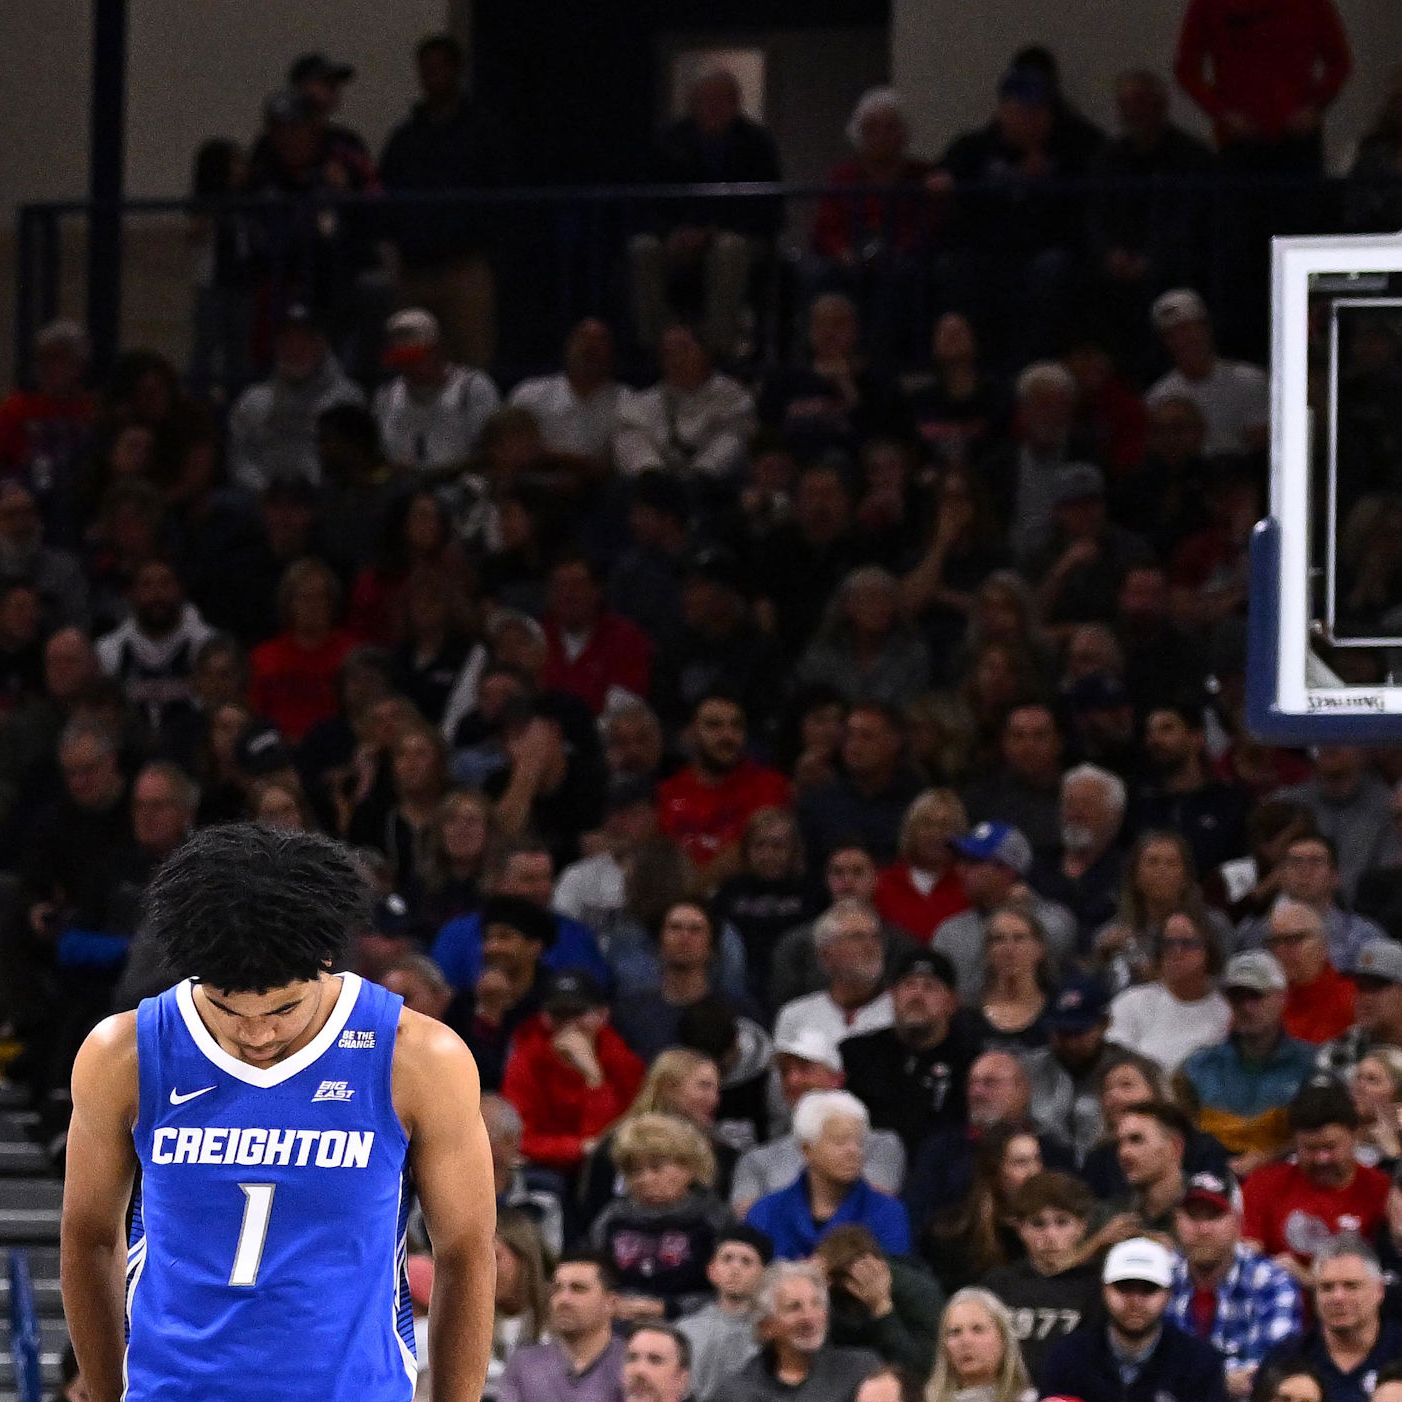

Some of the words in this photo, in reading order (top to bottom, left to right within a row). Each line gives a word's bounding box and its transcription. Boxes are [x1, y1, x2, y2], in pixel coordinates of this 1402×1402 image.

[342, 1030, 356, 1040] BE
[356, 1031, 375, 1041] THE
[338, 1039, 376, 1049] CHANGE
[318, 1080, 349, 1091] BIG
[313, 1089, 356, 1099] EAST
[151, 1127, 375, 1169] CREIGHTON
[228, 1182, 277, 1287] 1
